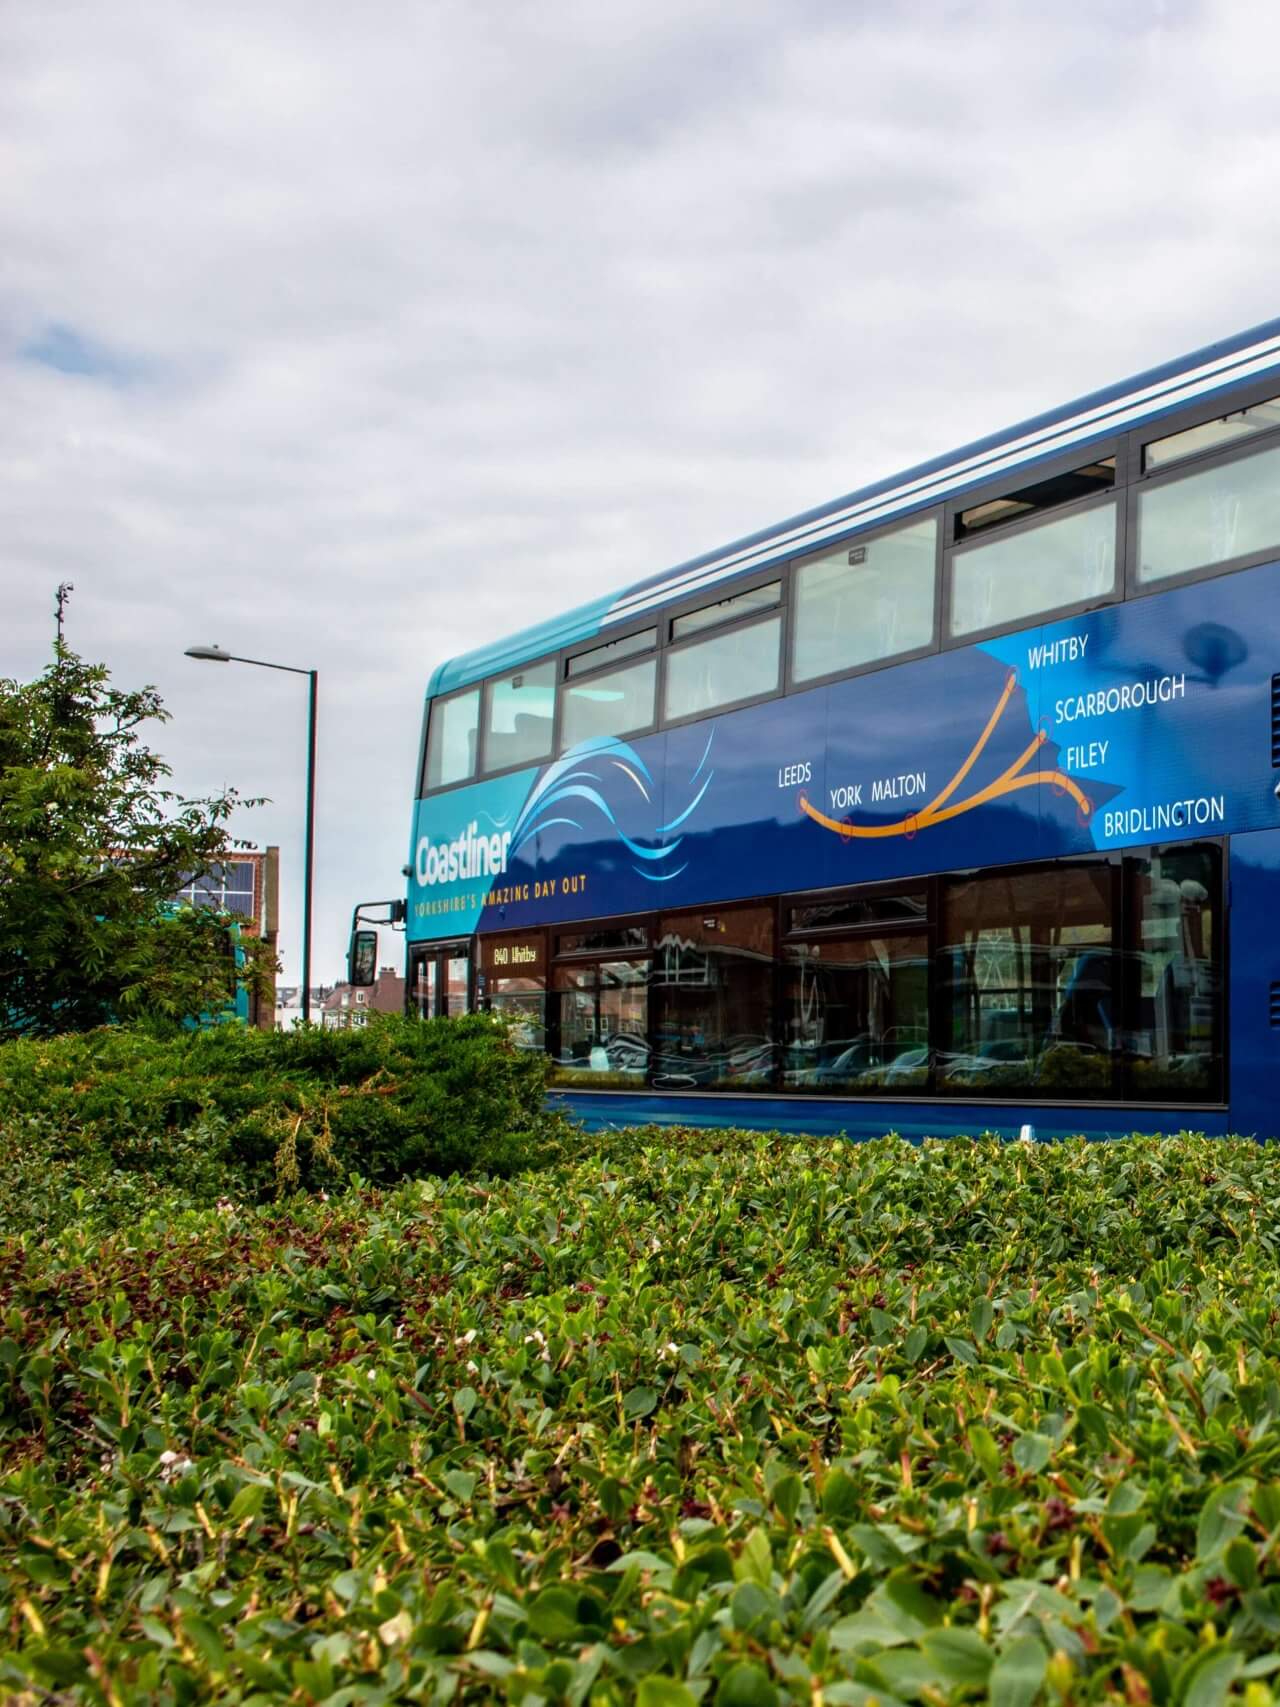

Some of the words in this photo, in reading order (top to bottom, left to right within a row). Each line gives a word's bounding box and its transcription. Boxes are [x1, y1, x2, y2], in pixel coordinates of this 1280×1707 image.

[1028, 634, 1089, 670] WHITBY
[1055, 673, 1186, 724] SCARBOROUGH
[1067, 740, 1109, 770] FILEY
[778, 762, 812, 788] LEEDS
[871, 772, 926, 802] MALTON
[830, 784, 862, 809] YORK
[1104, 796, 1224, 837] BRIDLINGTON
[416, 821, 511, 887] Coastliner
[415, 894, 476, 917] YORKSHIRE'S
[481, 882, 529, 906] AMAZING
[534, 880, 556, 898] DAY
[562, 875, 587, 893] OUT
[494, 947, 508, 965] 840
[512, 945, 536, 964] Whitby
